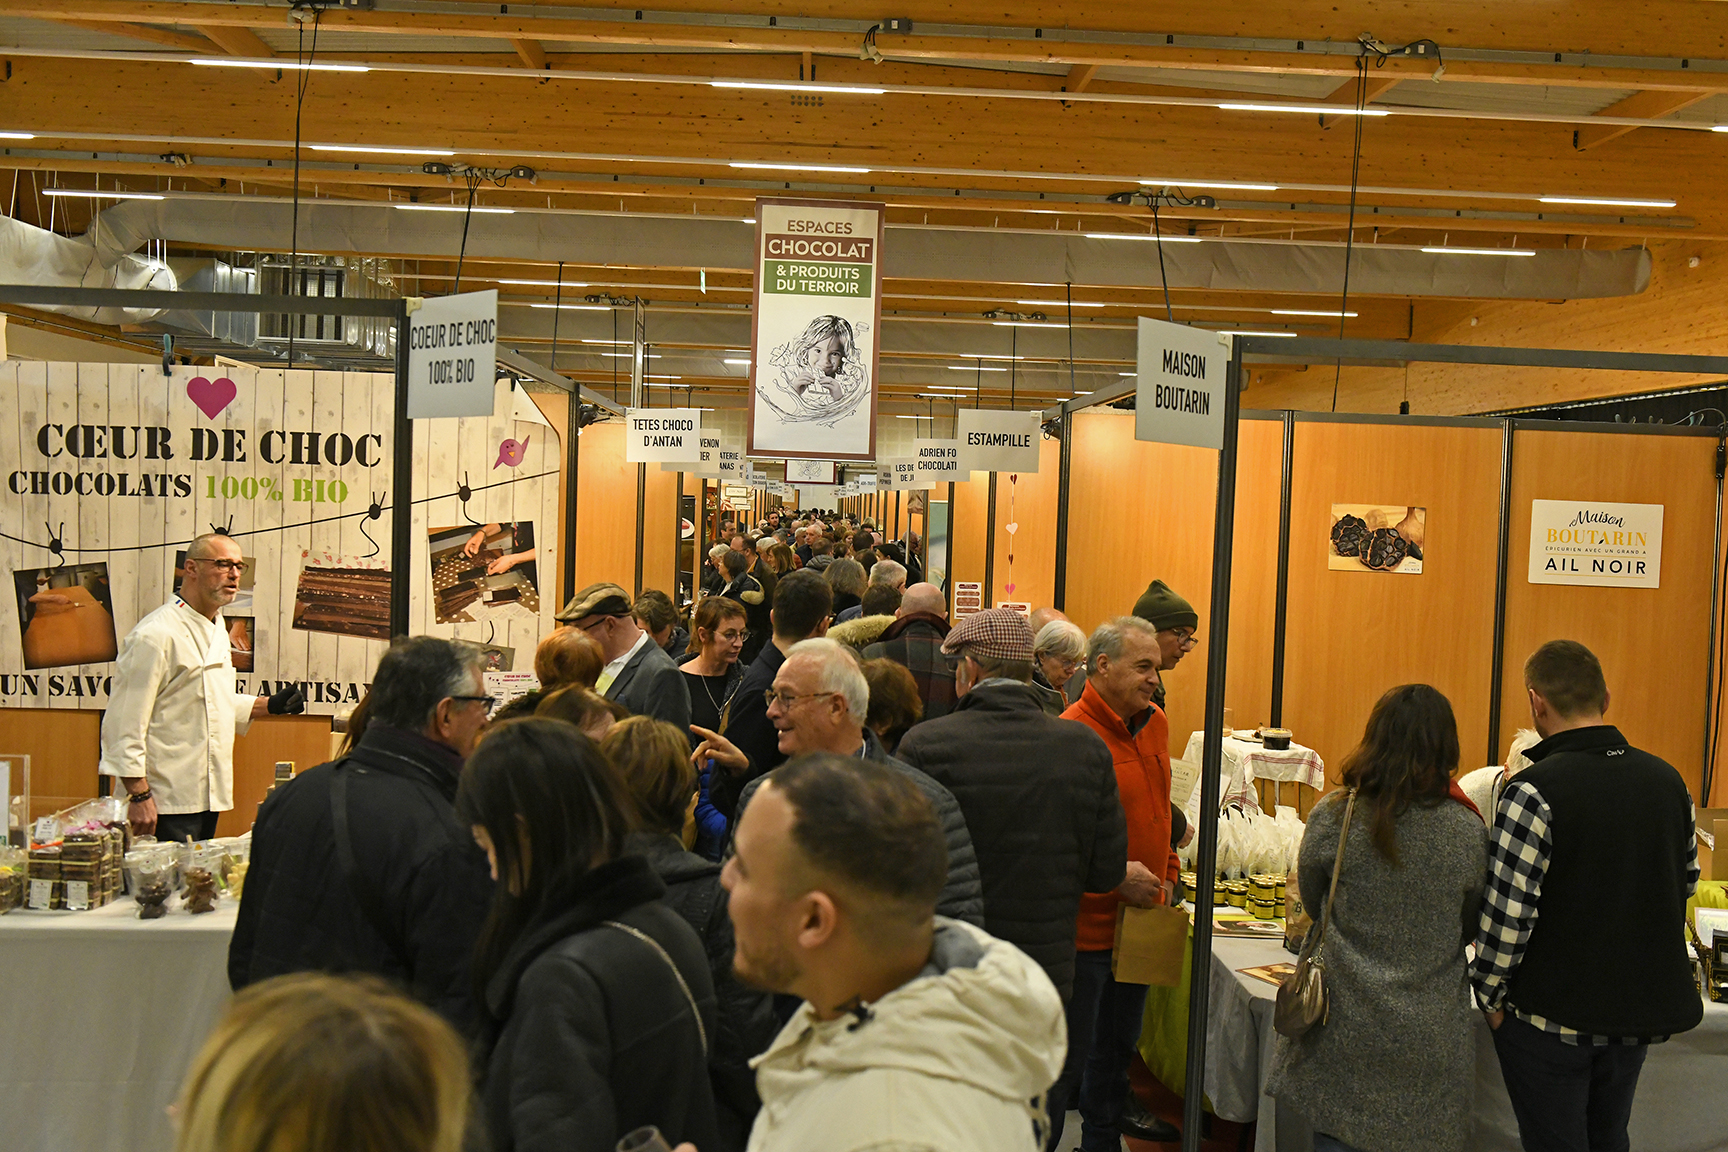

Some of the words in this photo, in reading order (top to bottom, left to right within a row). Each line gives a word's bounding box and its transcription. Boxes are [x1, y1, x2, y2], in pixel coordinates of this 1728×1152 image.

[787, 220, 853, 235] ESPACES
[768, 239, 870, 258] CHOCOLAT
[776, 264, 787, 276] &
[789, 265, 860, 280] PRODUITS
[776, 279, 796, 291] DU
[799, 280, 859, 294] TERROIR
[411, 324, 446, 350] COEUR
[449, 322, 464, 347] DE
[466, 318, 495, 345] CHOC
[428, 359, 453, 385] 100%
[455, 358, 475, 383] BIO
[1163, 349, 1206, 379] MAISON
[1155, 384, 1210, 415] BOUTARIN
[633, 418, 660, 430] TETES
[662, 419, 693, 431] CHOCO
[37, 423, 174, 461] CŒUR
[189, 428, 247, 463] DE
[259, 430, 382, 467] CHOC
[644, 435, 682, 447] D'ANTAN
[967, 432, 1031, 448] ESTAMPILLE
[919, 448, 945, 457] ADRIEN
[895, 464, 906, 472] LES
[8, 471, 191, 498] CHOCOLATS
[205, 475, 283, 501] 100%
[292, 478, 349, 504] BIO
[1569, 510, 1626, 528] Maison
[1546, 528, 1647, 546] BOUTARIN
[1545, 557, 1579, 571] AIL
[1592, 559, 1646, 574] NOIR
[0, 674, 39, 696] UN
